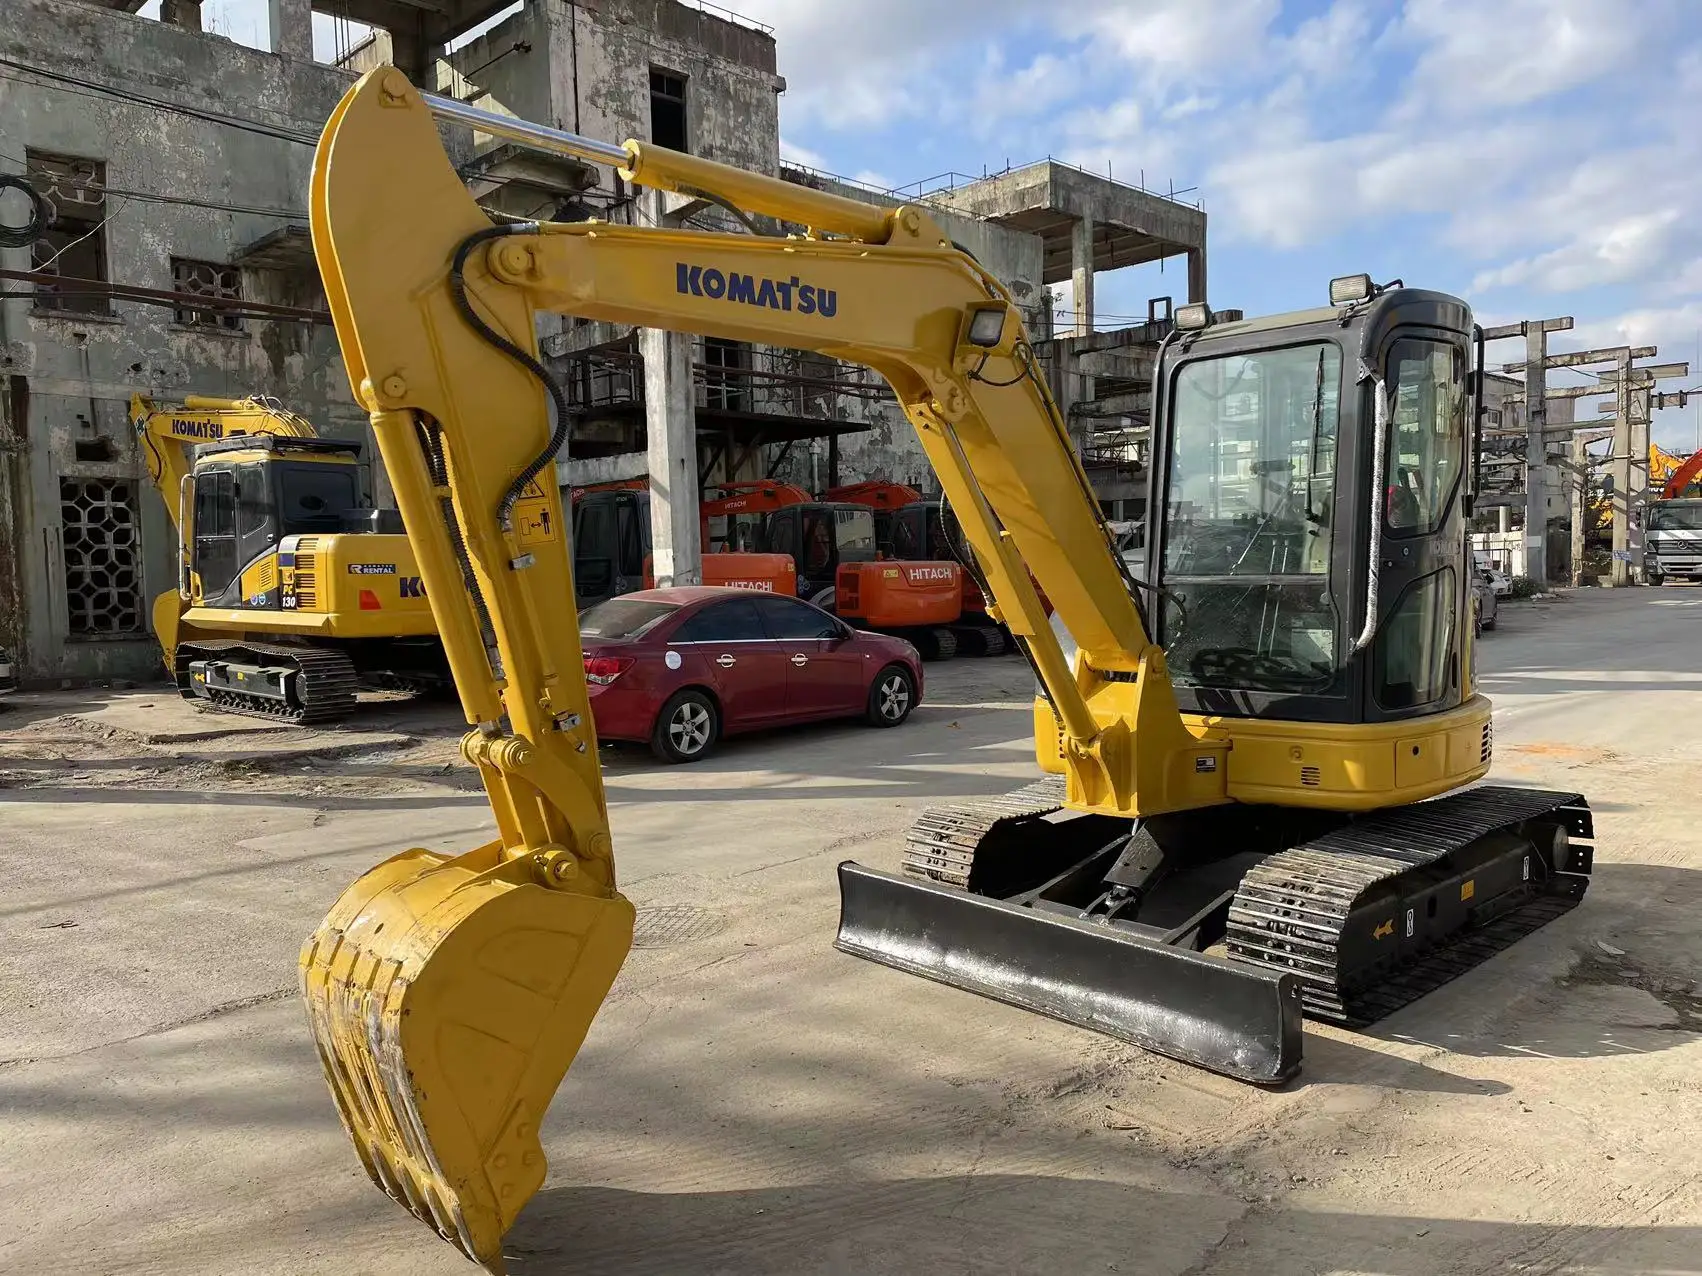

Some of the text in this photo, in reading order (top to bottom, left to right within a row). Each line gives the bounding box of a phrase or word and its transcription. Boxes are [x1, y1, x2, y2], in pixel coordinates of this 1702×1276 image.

[676, 262, 837, 318] KOMATSU
[172, 418, 223, 439] KOMATSU
[724, 500, 747, 509] HITACHI
[283, 584, 293, 595] PC
[282, 597, 296, 607] 130
